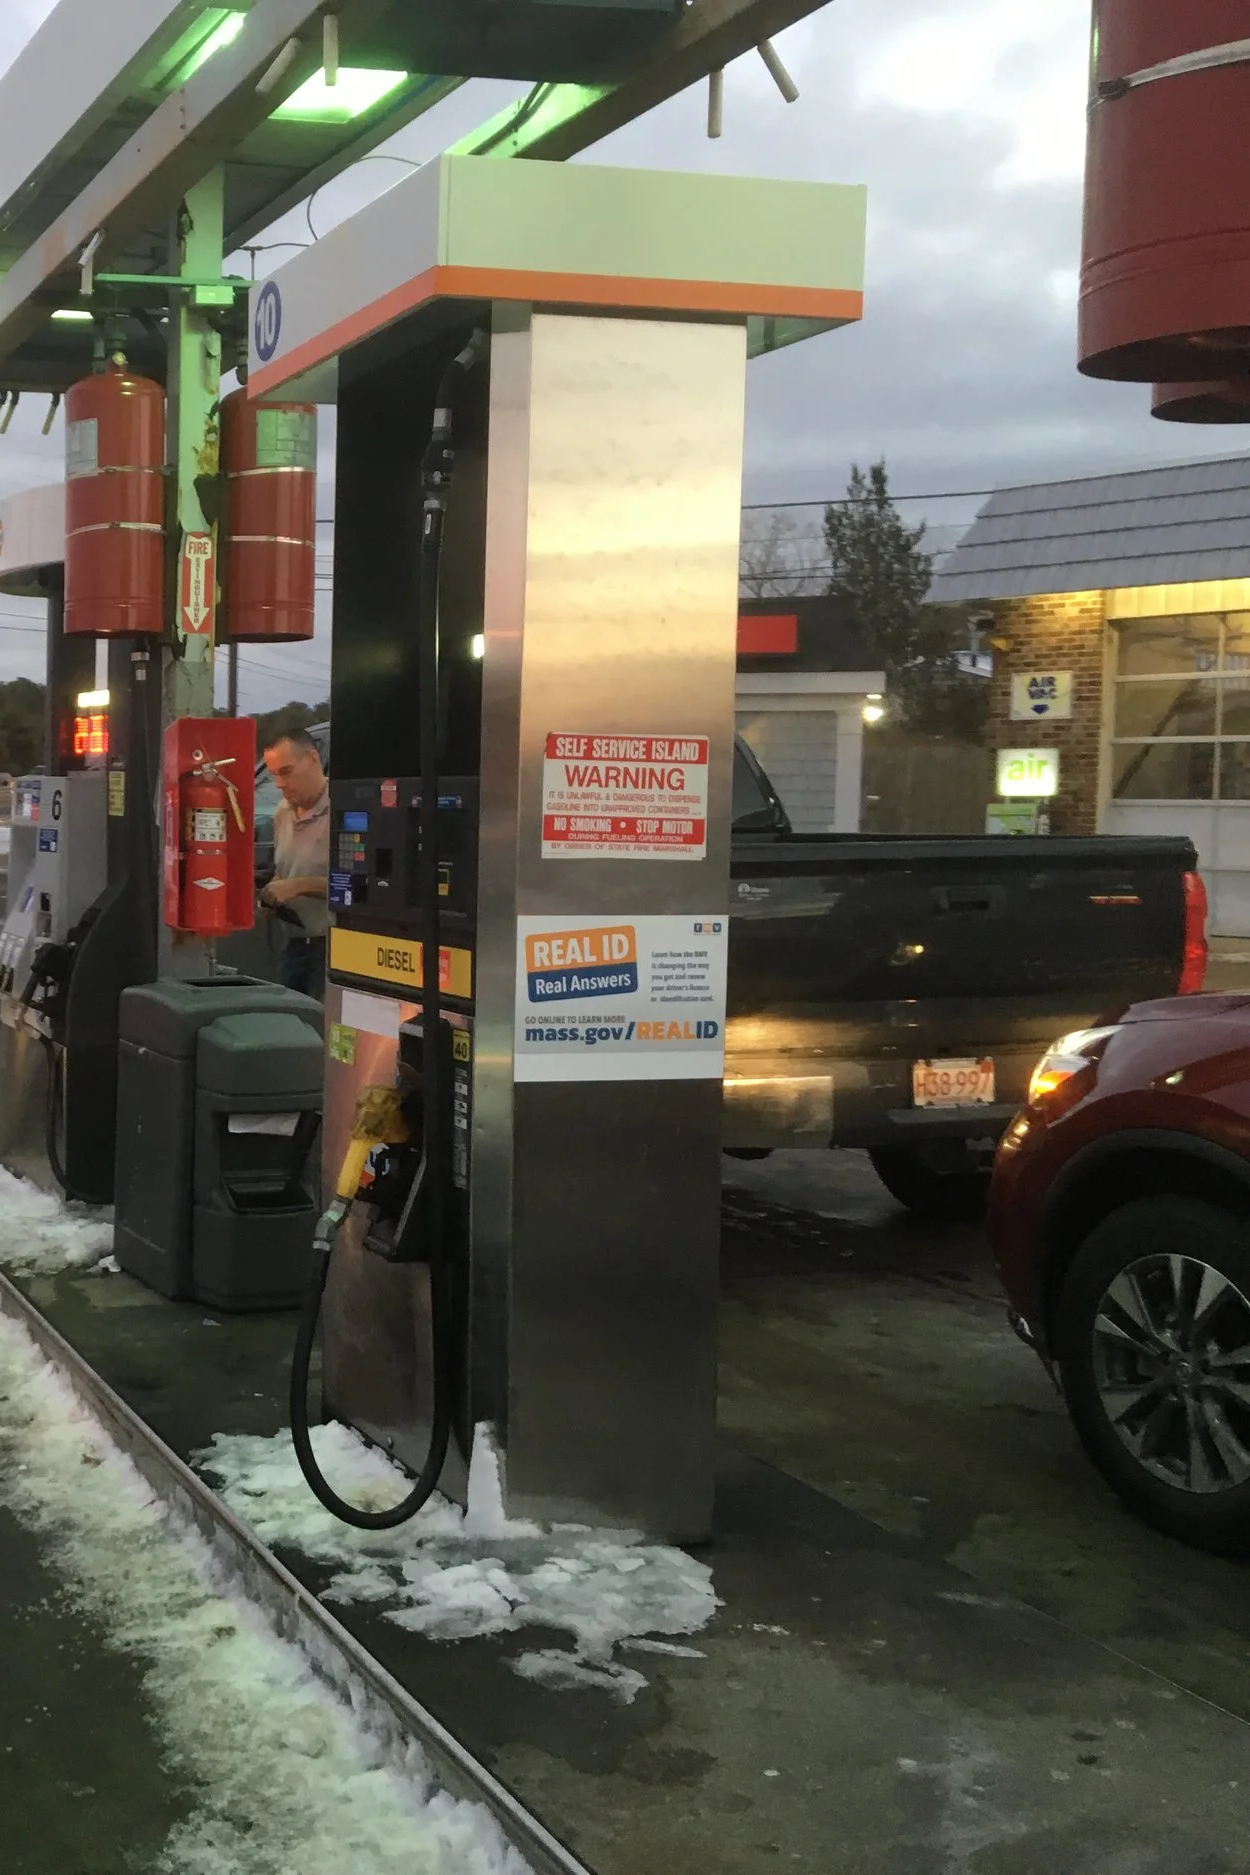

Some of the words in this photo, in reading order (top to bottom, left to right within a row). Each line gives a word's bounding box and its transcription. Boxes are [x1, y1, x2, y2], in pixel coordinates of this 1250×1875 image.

[257, 292, 276, 350] 10
[189, 541, 209, 554] FIRE
[1029, 676, 1056, 687] AIR
[556, 737, 588, 757] SELF
[592, 739, 646, 759] SERVICE
[651, 741, 699, 761] ISLAND
[1008, 753, 1049, 780] air
[565, 764, 685, 791] WARNING
[52, 789, 62, 821] 6
[549, 791, 557, 799] IT
[557, 791, 565, 799] IS
[567, 792, 602, 801] UNLAWFUL
[605, 793, 611, 801] &
[613, 793, 655, 802] DANGEROUS
[658, 795, 666, 803] TO
[669, 795, 701, 804] DISPENSE
[547, 803, 580, 812] GASOLINE
[583, 803, 599, 812] INTO
[601, 804, 646, 814] UNAPPROVED
[648, 806, 690, 815] CONTAINERS
[554, 817, 567, 831] NO
[570, 818, 612, 833] SMOKING
[636, 819, 659, 834] STOP
[662, 820, 693, 834] MOTOR
[568, 833, 599, 841] DURING
[639, 835, 683, 843] OPERATION
[533, 937, 597, 967] REAL
[602, 933, 629, 960] ID
[377, 947, 416, 973] DIESEL
[658, 962, 685, 970] changing
[535, 976, 567, 995] Real
[571, 973, 631, 991] Answers
[664, 973, 674, 982] get
[525, 1016, 536, 1024] GO
[538, 1016, 566, 1024] ONLINE
[567, 1016, 577, 1024] TO
[578, 1016, 602, 1024] LEARN
[604, 1015, 626, 1023] MORE
[525, 1021, 719, 1045] mass.gov/REALID
[455, 1042, 467, 1059] 40
